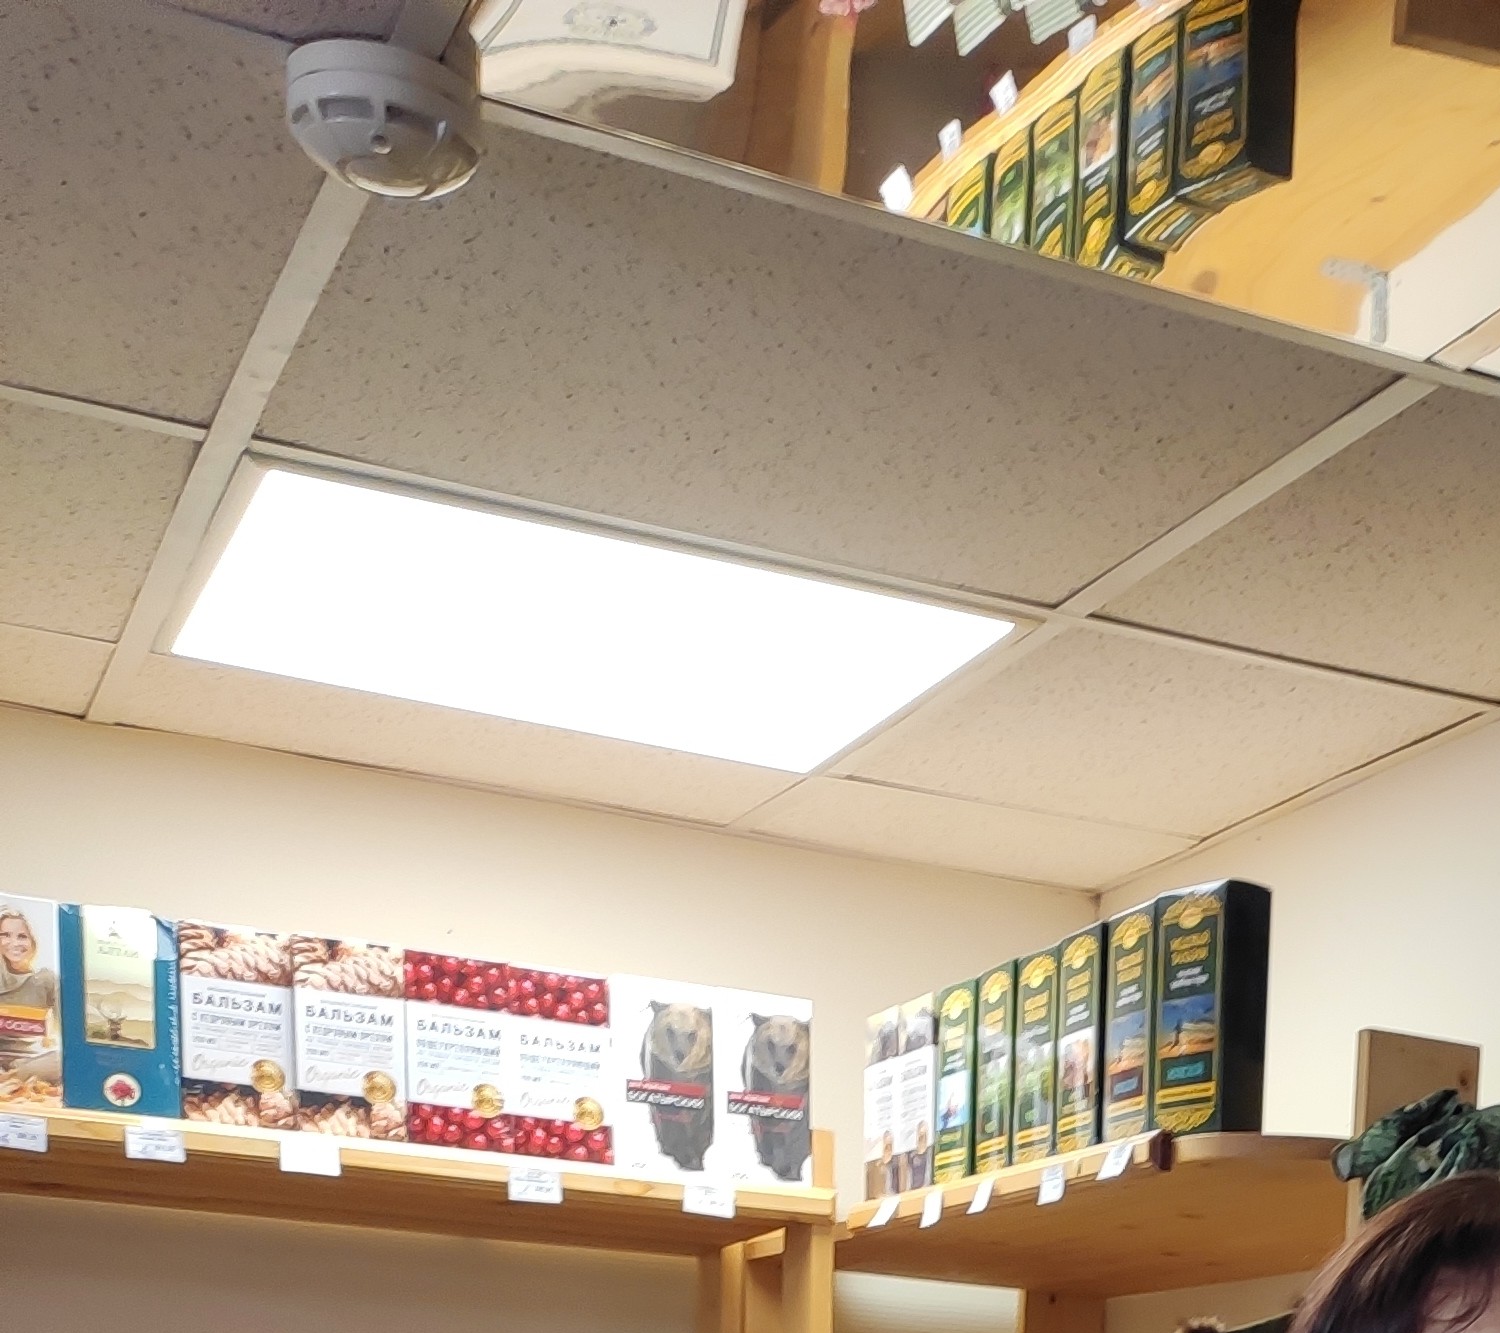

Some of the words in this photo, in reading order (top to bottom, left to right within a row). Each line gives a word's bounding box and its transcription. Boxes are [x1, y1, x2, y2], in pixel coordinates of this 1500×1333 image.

[192, 992, 283, 1016] БАЛЬЗАМ
[305, 1005, 394, 1028] БАЛЬЗАМ
[416, 1019, 502, 1041] БАЛЬЗАМ
[520, 1034, 601, 1053] БАЛЬЗАМ
